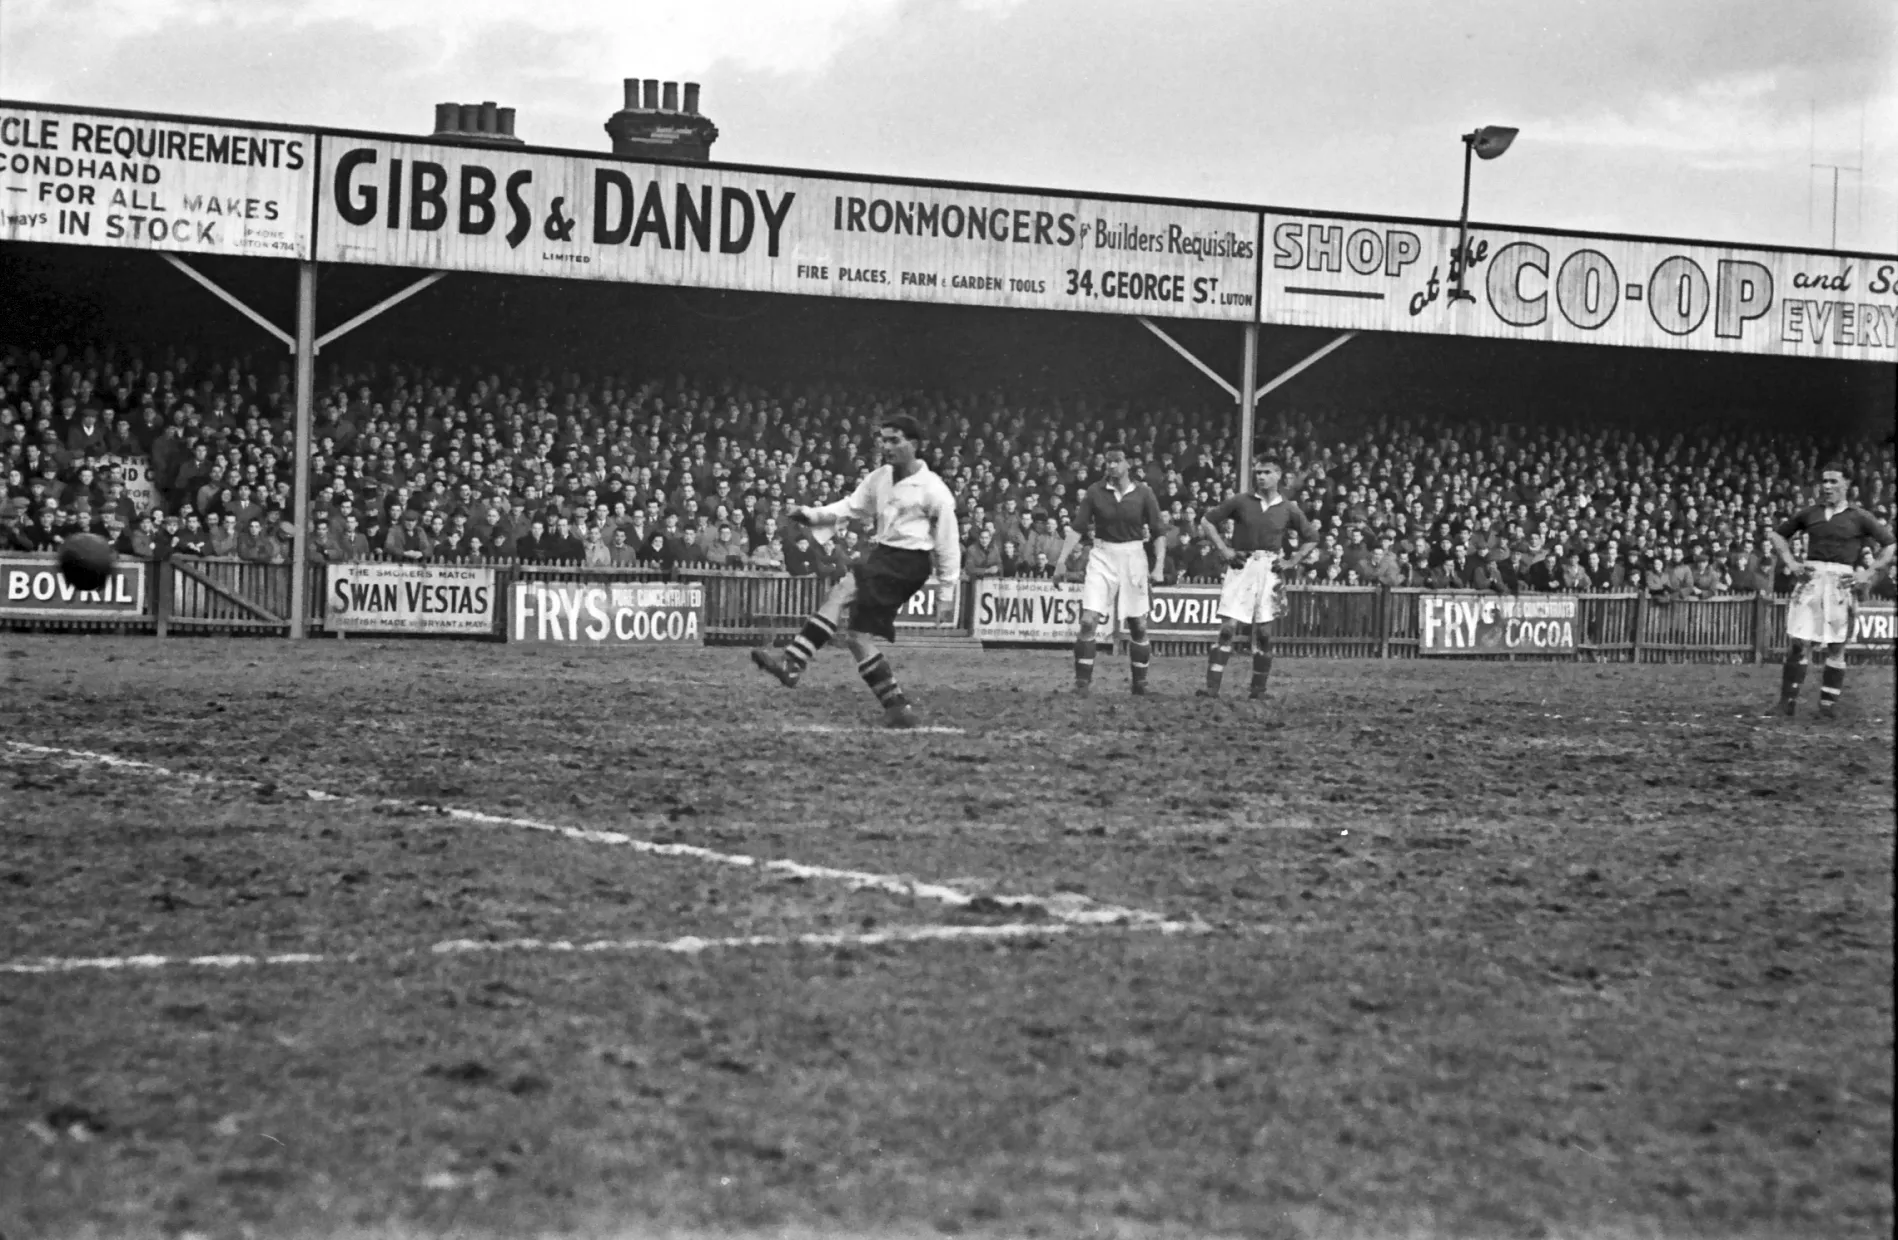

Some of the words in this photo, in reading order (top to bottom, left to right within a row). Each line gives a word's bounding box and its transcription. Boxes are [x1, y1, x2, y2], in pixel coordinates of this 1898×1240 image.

[0, 116, 59, 150] CLE
[72, 123, 304, 171] REQUIREMENTS
[39, 182, 95, 205] FOR
[110, 189, 167, 212] ALL
[184, 194, 279, 220] MAKES
[334, 148, 533, 250] GIBBS
[543, 197, 576, 243] &
[593, 168, 796, 258] DANDY
[60, 210, 91, 236] IN
[106, 214, 216, 245] STOCK
[834, 196, 1076, 247] IRONMONGERS
[1095, 218, 1163, 254] Builders
[1168, 224, 1254, 262] Requisites
[542, 252, 591, 264] LIMITED
[798, 264, 829, 281] FIRE
[901, 270, 937, 287] FARM
[952, 274, 1002, 292] GARDEN
[1009, 277, 1045, 294] TOOLS
[1101, 270, 1185, 302] GEORGE
[1220, 292, 1253, 306] LUTON
[1273, 222, 1421, 278] SHOP
[1409, 266, 1440, 316] at
[1486, 241, 1774, 340] CO-OP
[1793, 265, 1853, 292] and
[1781, 298, 1898, 348] EVERY
[349, 568, 370, 577] THE
[439, 571, 476, 580] MATCH
[1016, 583, 1063, 592] SMOKER
[333, 578, 397, 614] SWAN
[405, 581, 488, 614] VESTAS
[979, 593, 1034, 625] SWAN
[1151, 598, 1222, 624] OVRIL
[380, 618, 407, 628] MADE
[615, 607, 699, 641] COCOA
[1505, 619, 1573, 648] COCOA
